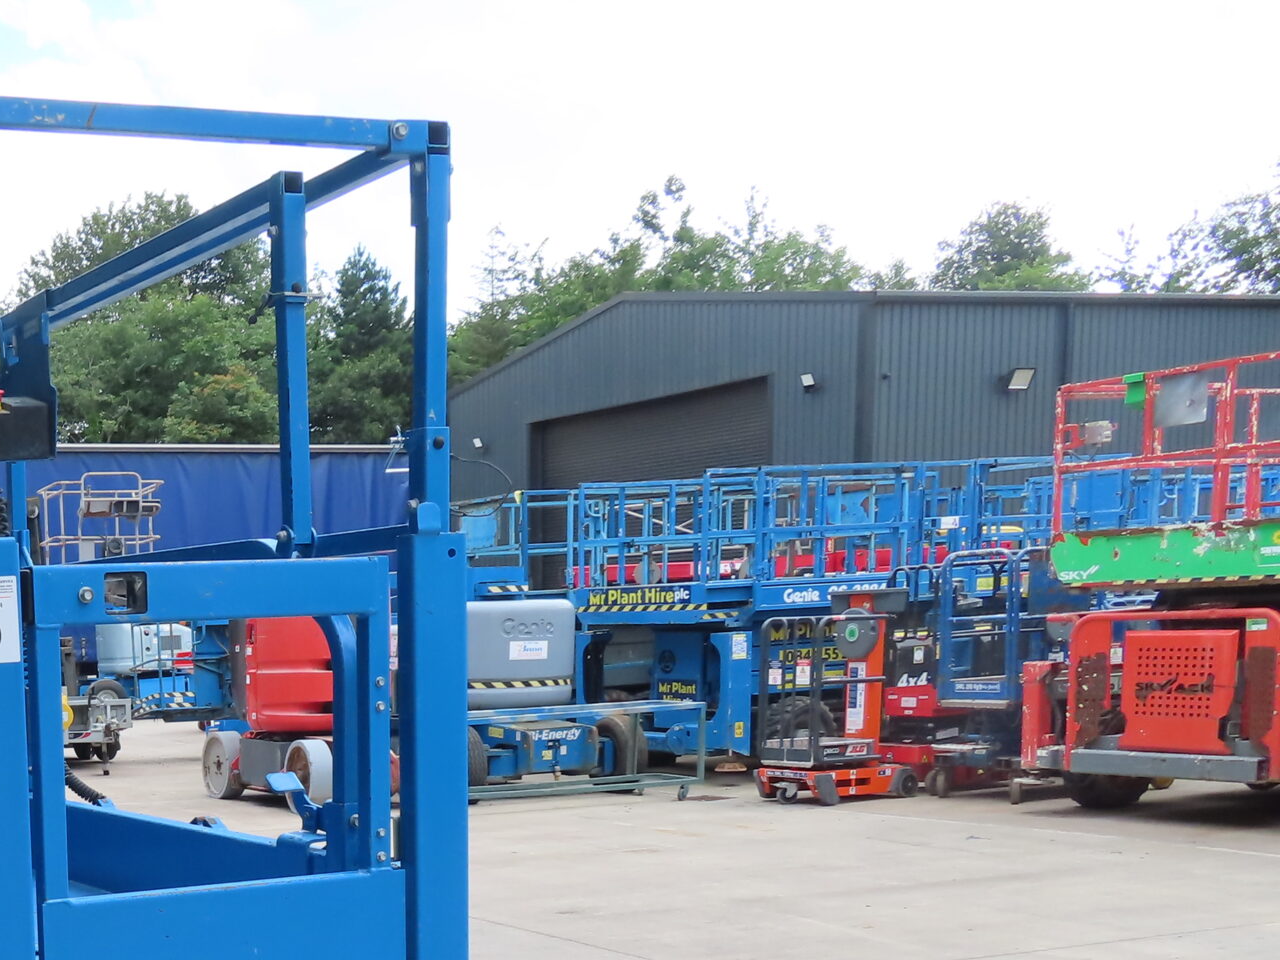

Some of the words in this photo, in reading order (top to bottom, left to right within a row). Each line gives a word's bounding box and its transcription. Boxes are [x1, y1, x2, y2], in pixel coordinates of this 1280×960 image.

[589, 592, 605, 605] Mr
[607, 589, 642, 604] Plant
[644, 588, 674, 603] Hire
[783, 588, 820, 603] Genie
[500, 617, 555, 638] Genie
[897, 672, 929, 687] 4x4
[658, 682, 671, 693] Mr
[671, 682, 696, 694] Plant
